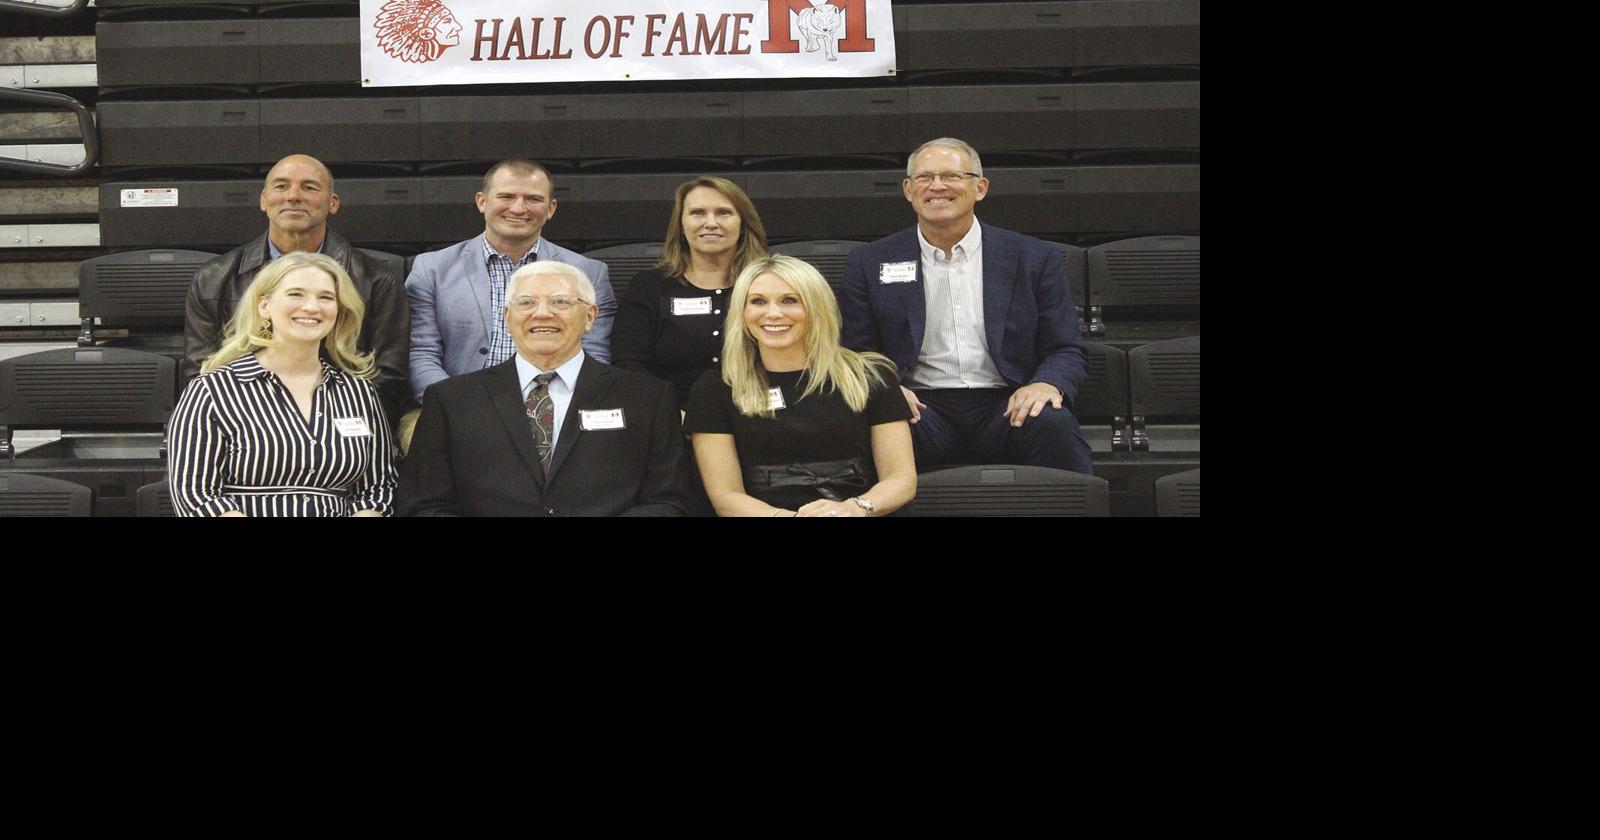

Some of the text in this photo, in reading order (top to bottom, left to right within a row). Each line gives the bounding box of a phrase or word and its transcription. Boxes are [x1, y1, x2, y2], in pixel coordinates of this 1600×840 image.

[470, 12, 753, 61] HALL OF FAME
